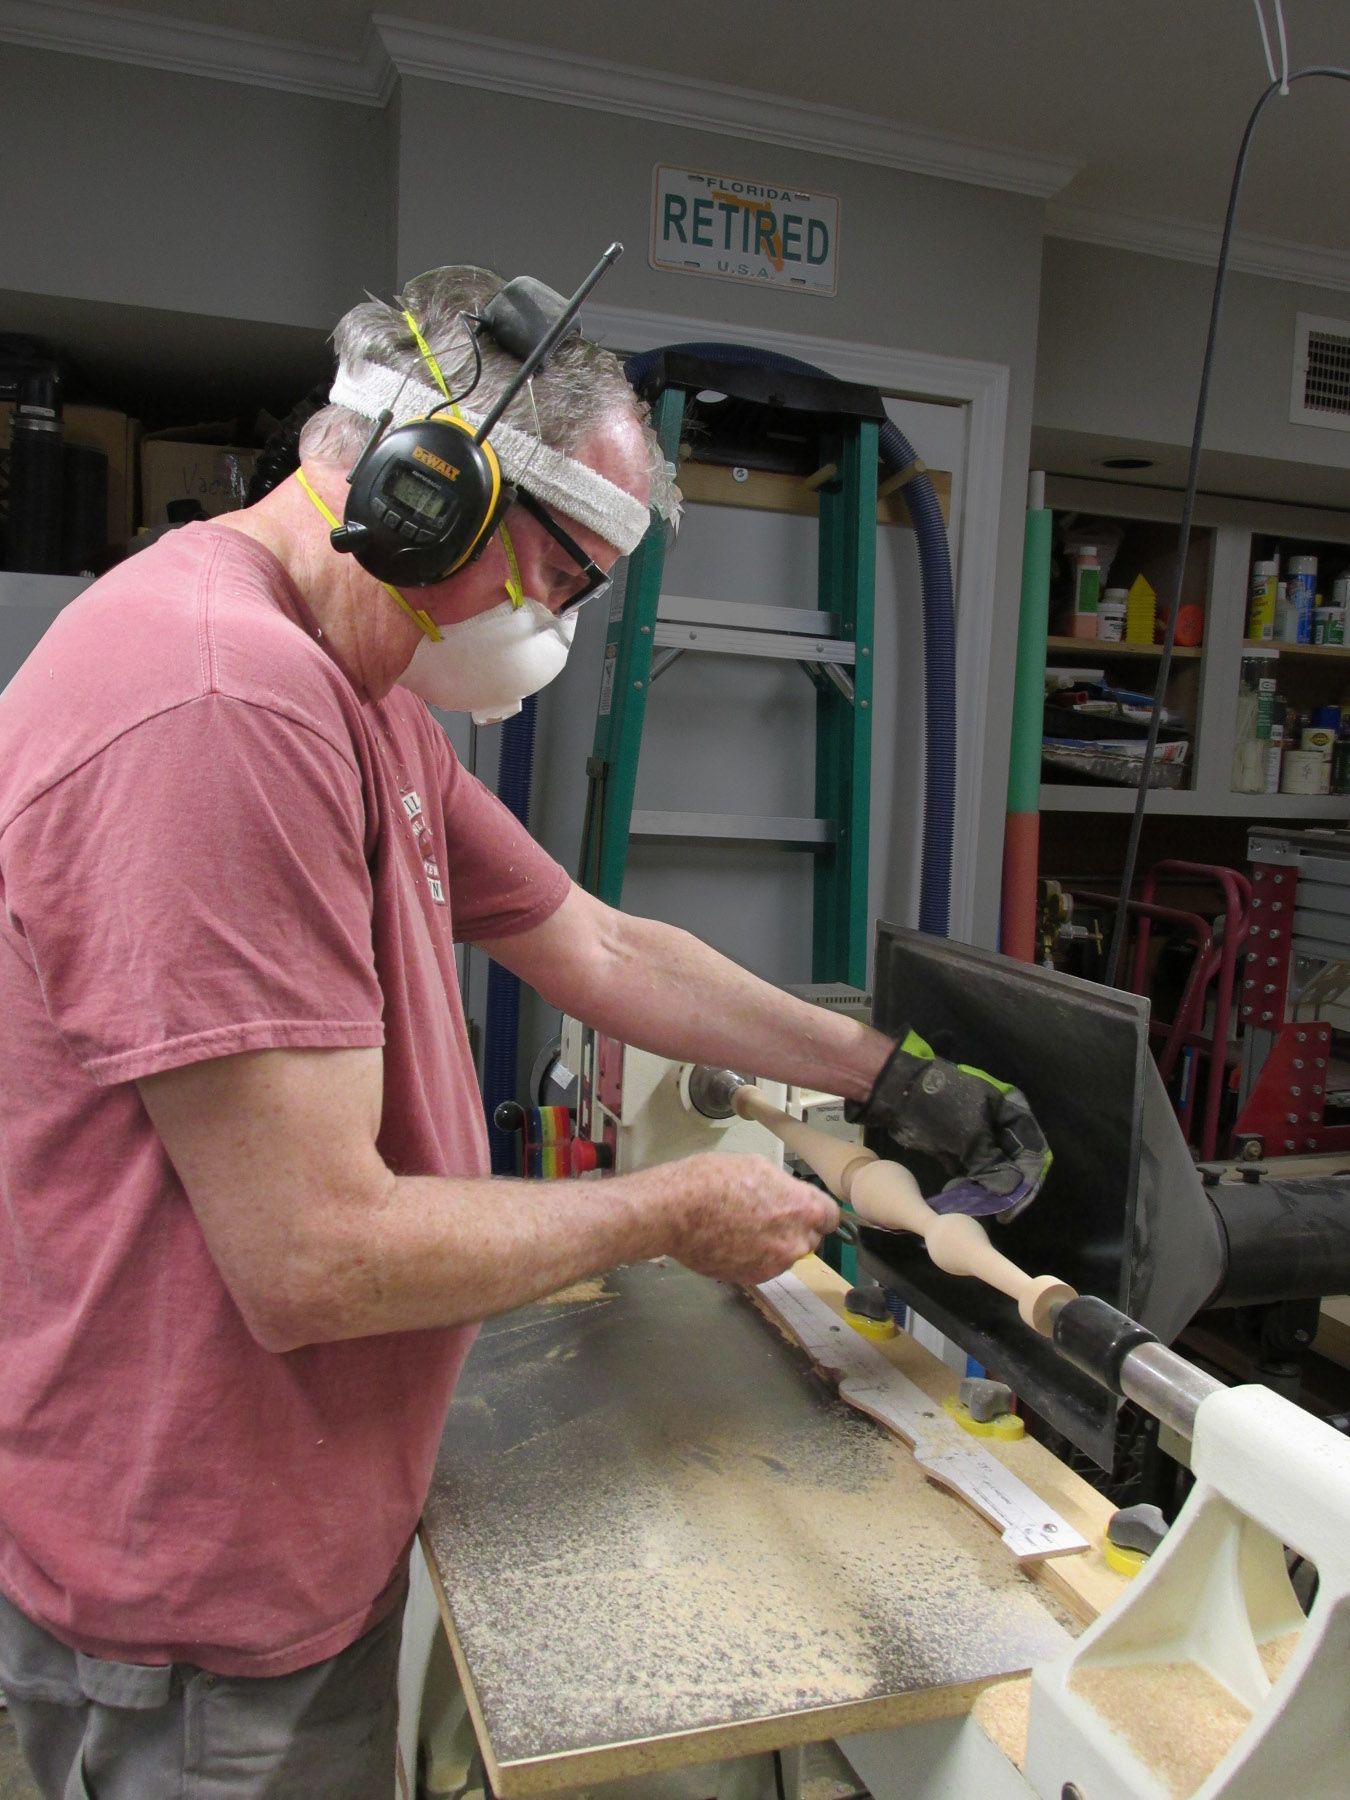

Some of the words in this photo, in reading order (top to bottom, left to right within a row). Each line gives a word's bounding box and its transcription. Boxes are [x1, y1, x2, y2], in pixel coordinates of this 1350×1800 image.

[707, 177, 792, 202] FLORIDA
[663, 193, 829, 265] RETIRED
[717, 260, 776, 279] U.S.A.
